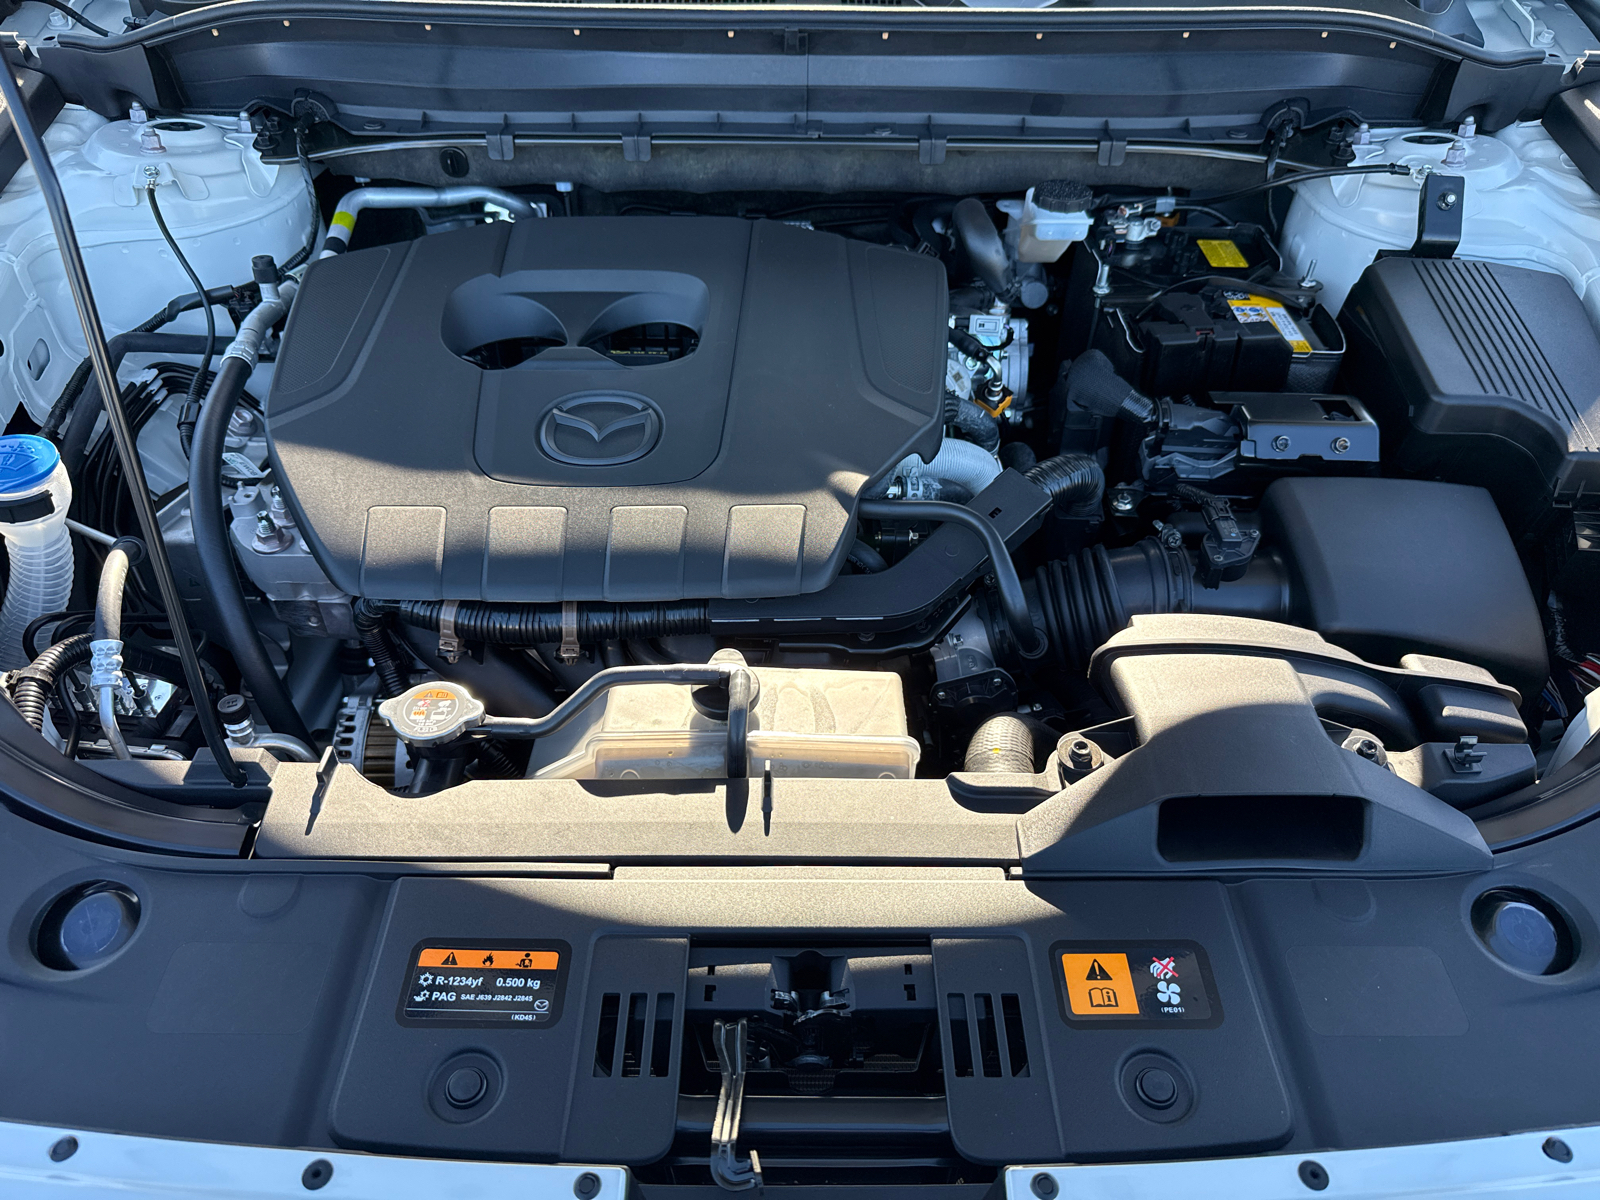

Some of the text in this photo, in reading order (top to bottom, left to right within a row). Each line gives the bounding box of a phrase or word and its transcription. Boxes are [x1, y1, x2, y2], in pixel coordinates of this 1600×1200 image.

[435, 975, 541, 990] R-1234yf 0.500 kg
[431, 991, 457, 1002] PAG
[460, 993, 476, 1001] SAE
[475, 994, 493, 1002] J639
